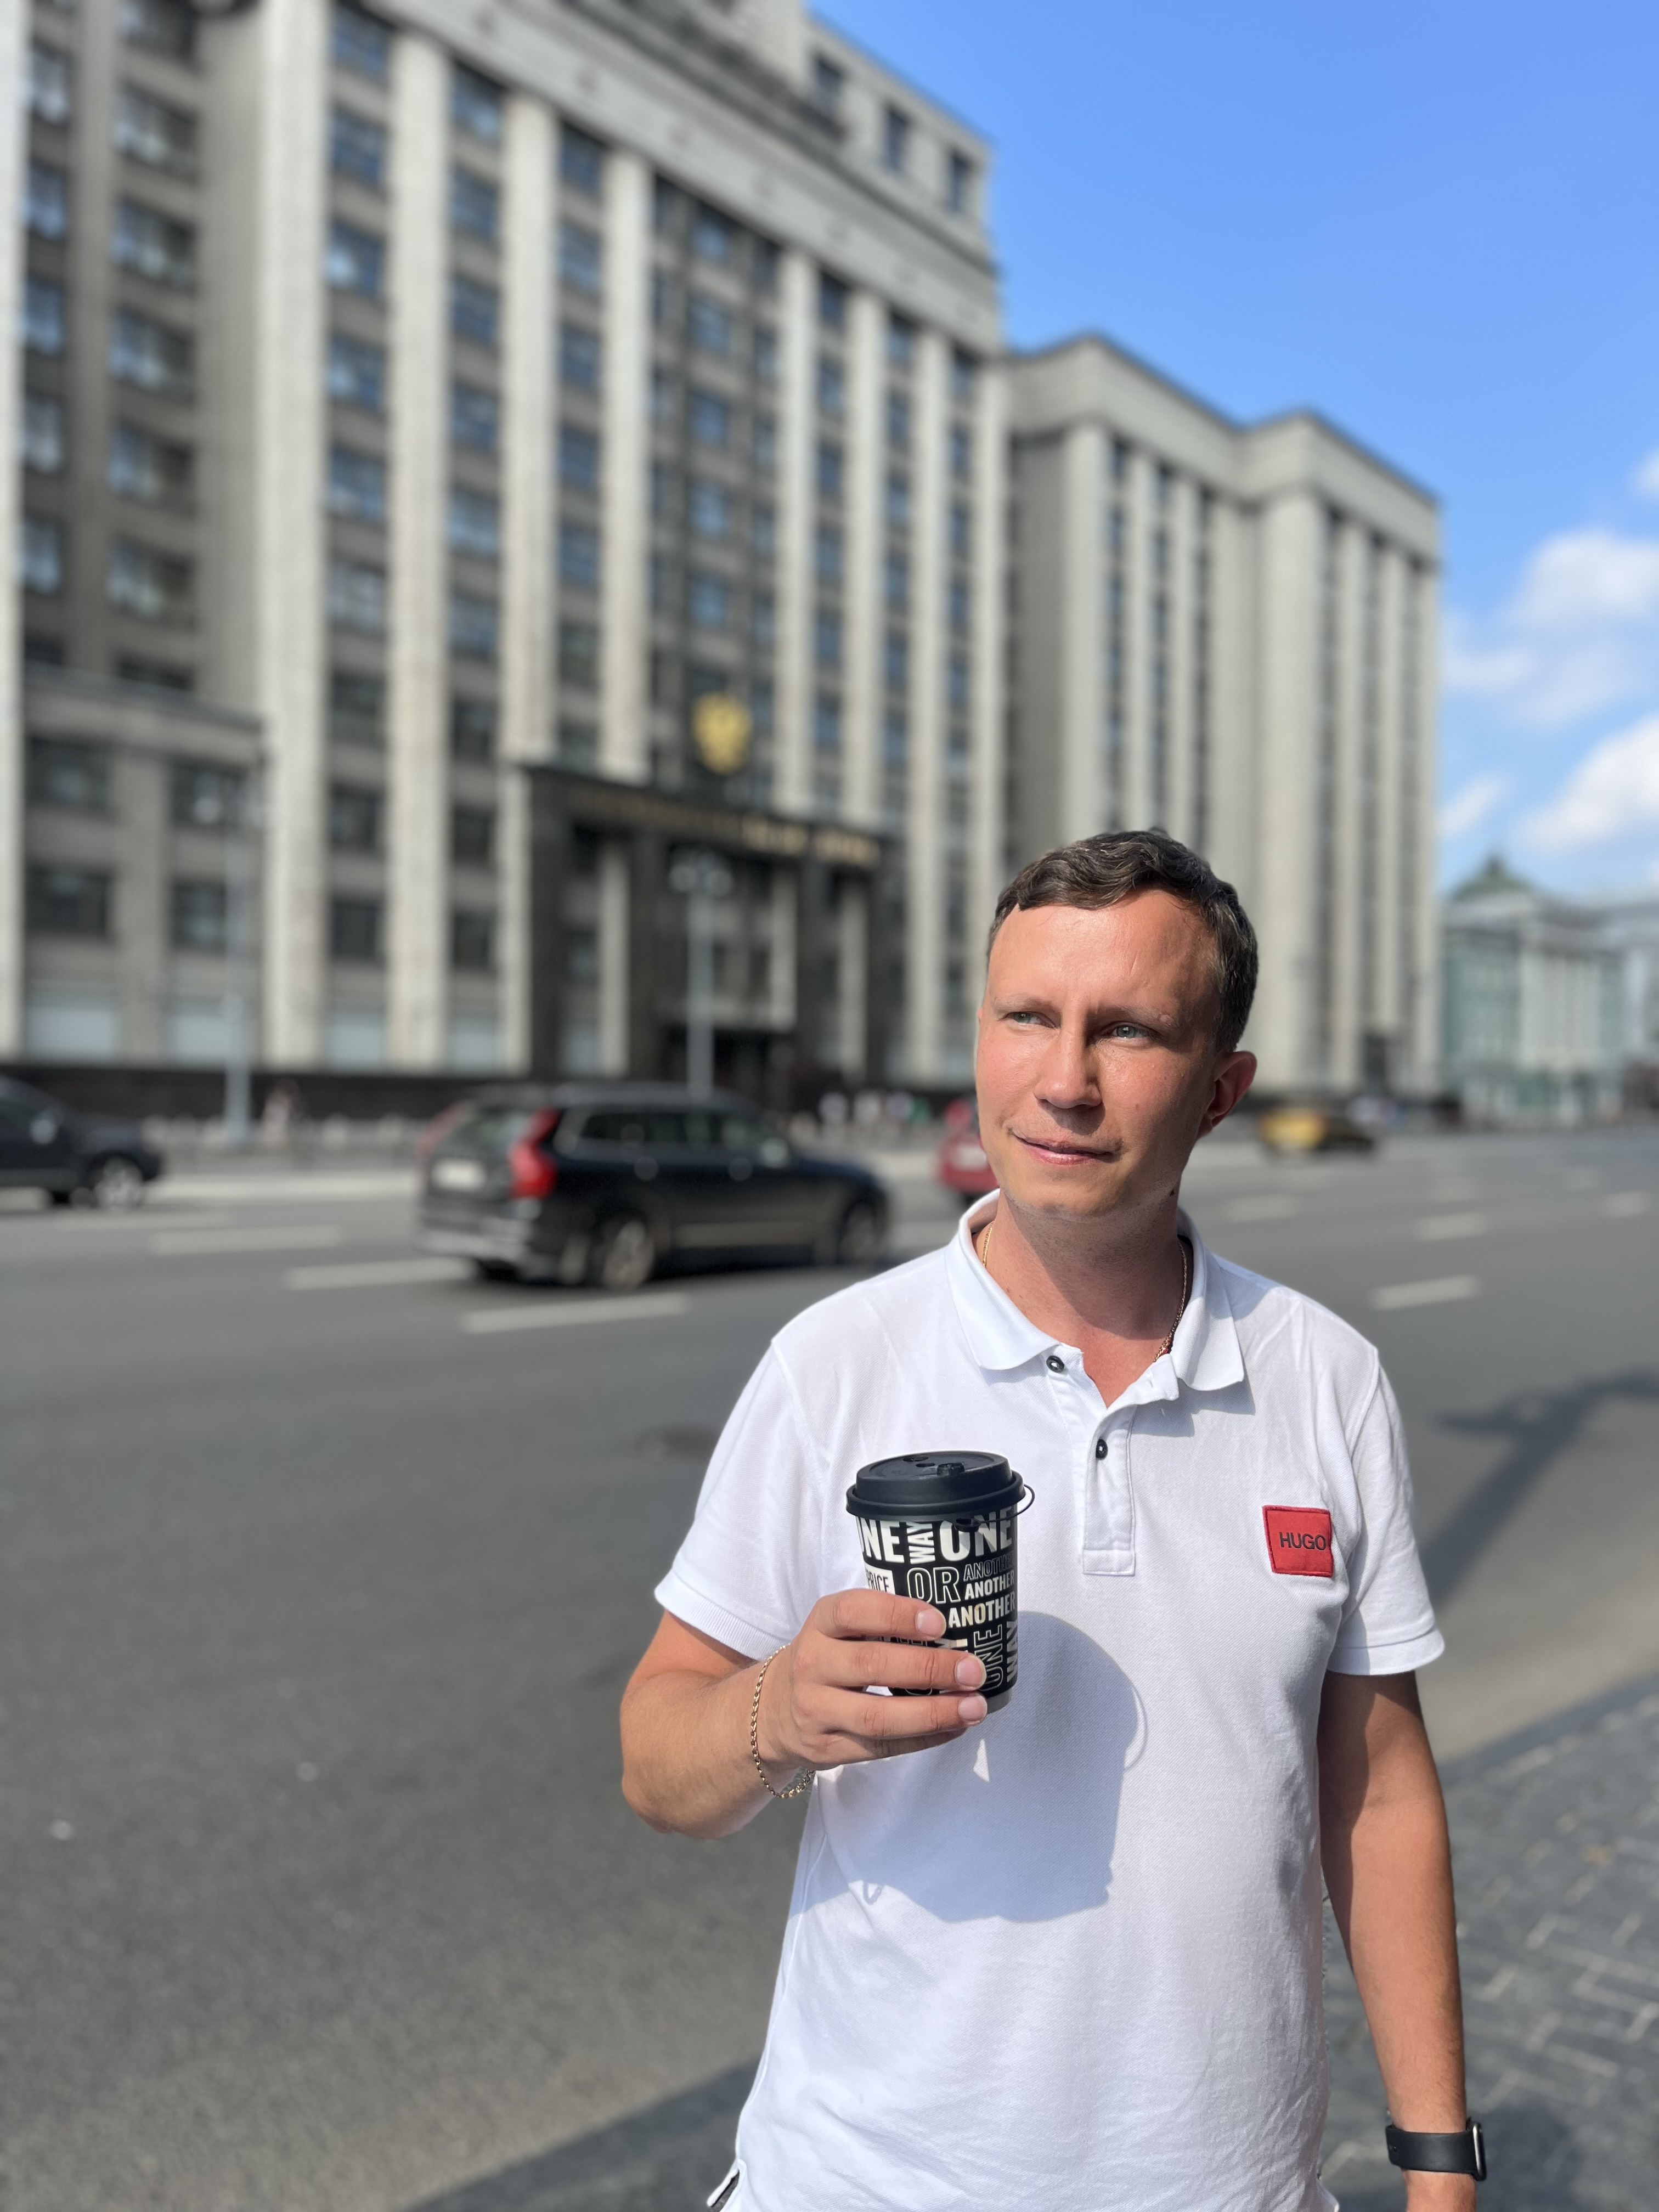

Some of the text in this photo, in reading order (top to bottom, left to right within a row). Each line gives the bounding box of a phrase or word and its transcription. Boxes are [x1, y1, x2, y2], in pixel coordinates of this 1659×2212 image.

[856, 1516, 905, 1564] NE
[906, 1521, 936, 1564] WAY
[940, 1506, 1012, 1562] ONE
[1279, 1532, 1326, 1550] HUGO
[907, 1566, 961, 1604] OR
[964, 1569, 1015, 1601] ANOTHER
[948, 1590, 1015, 1629] ANOTHER
